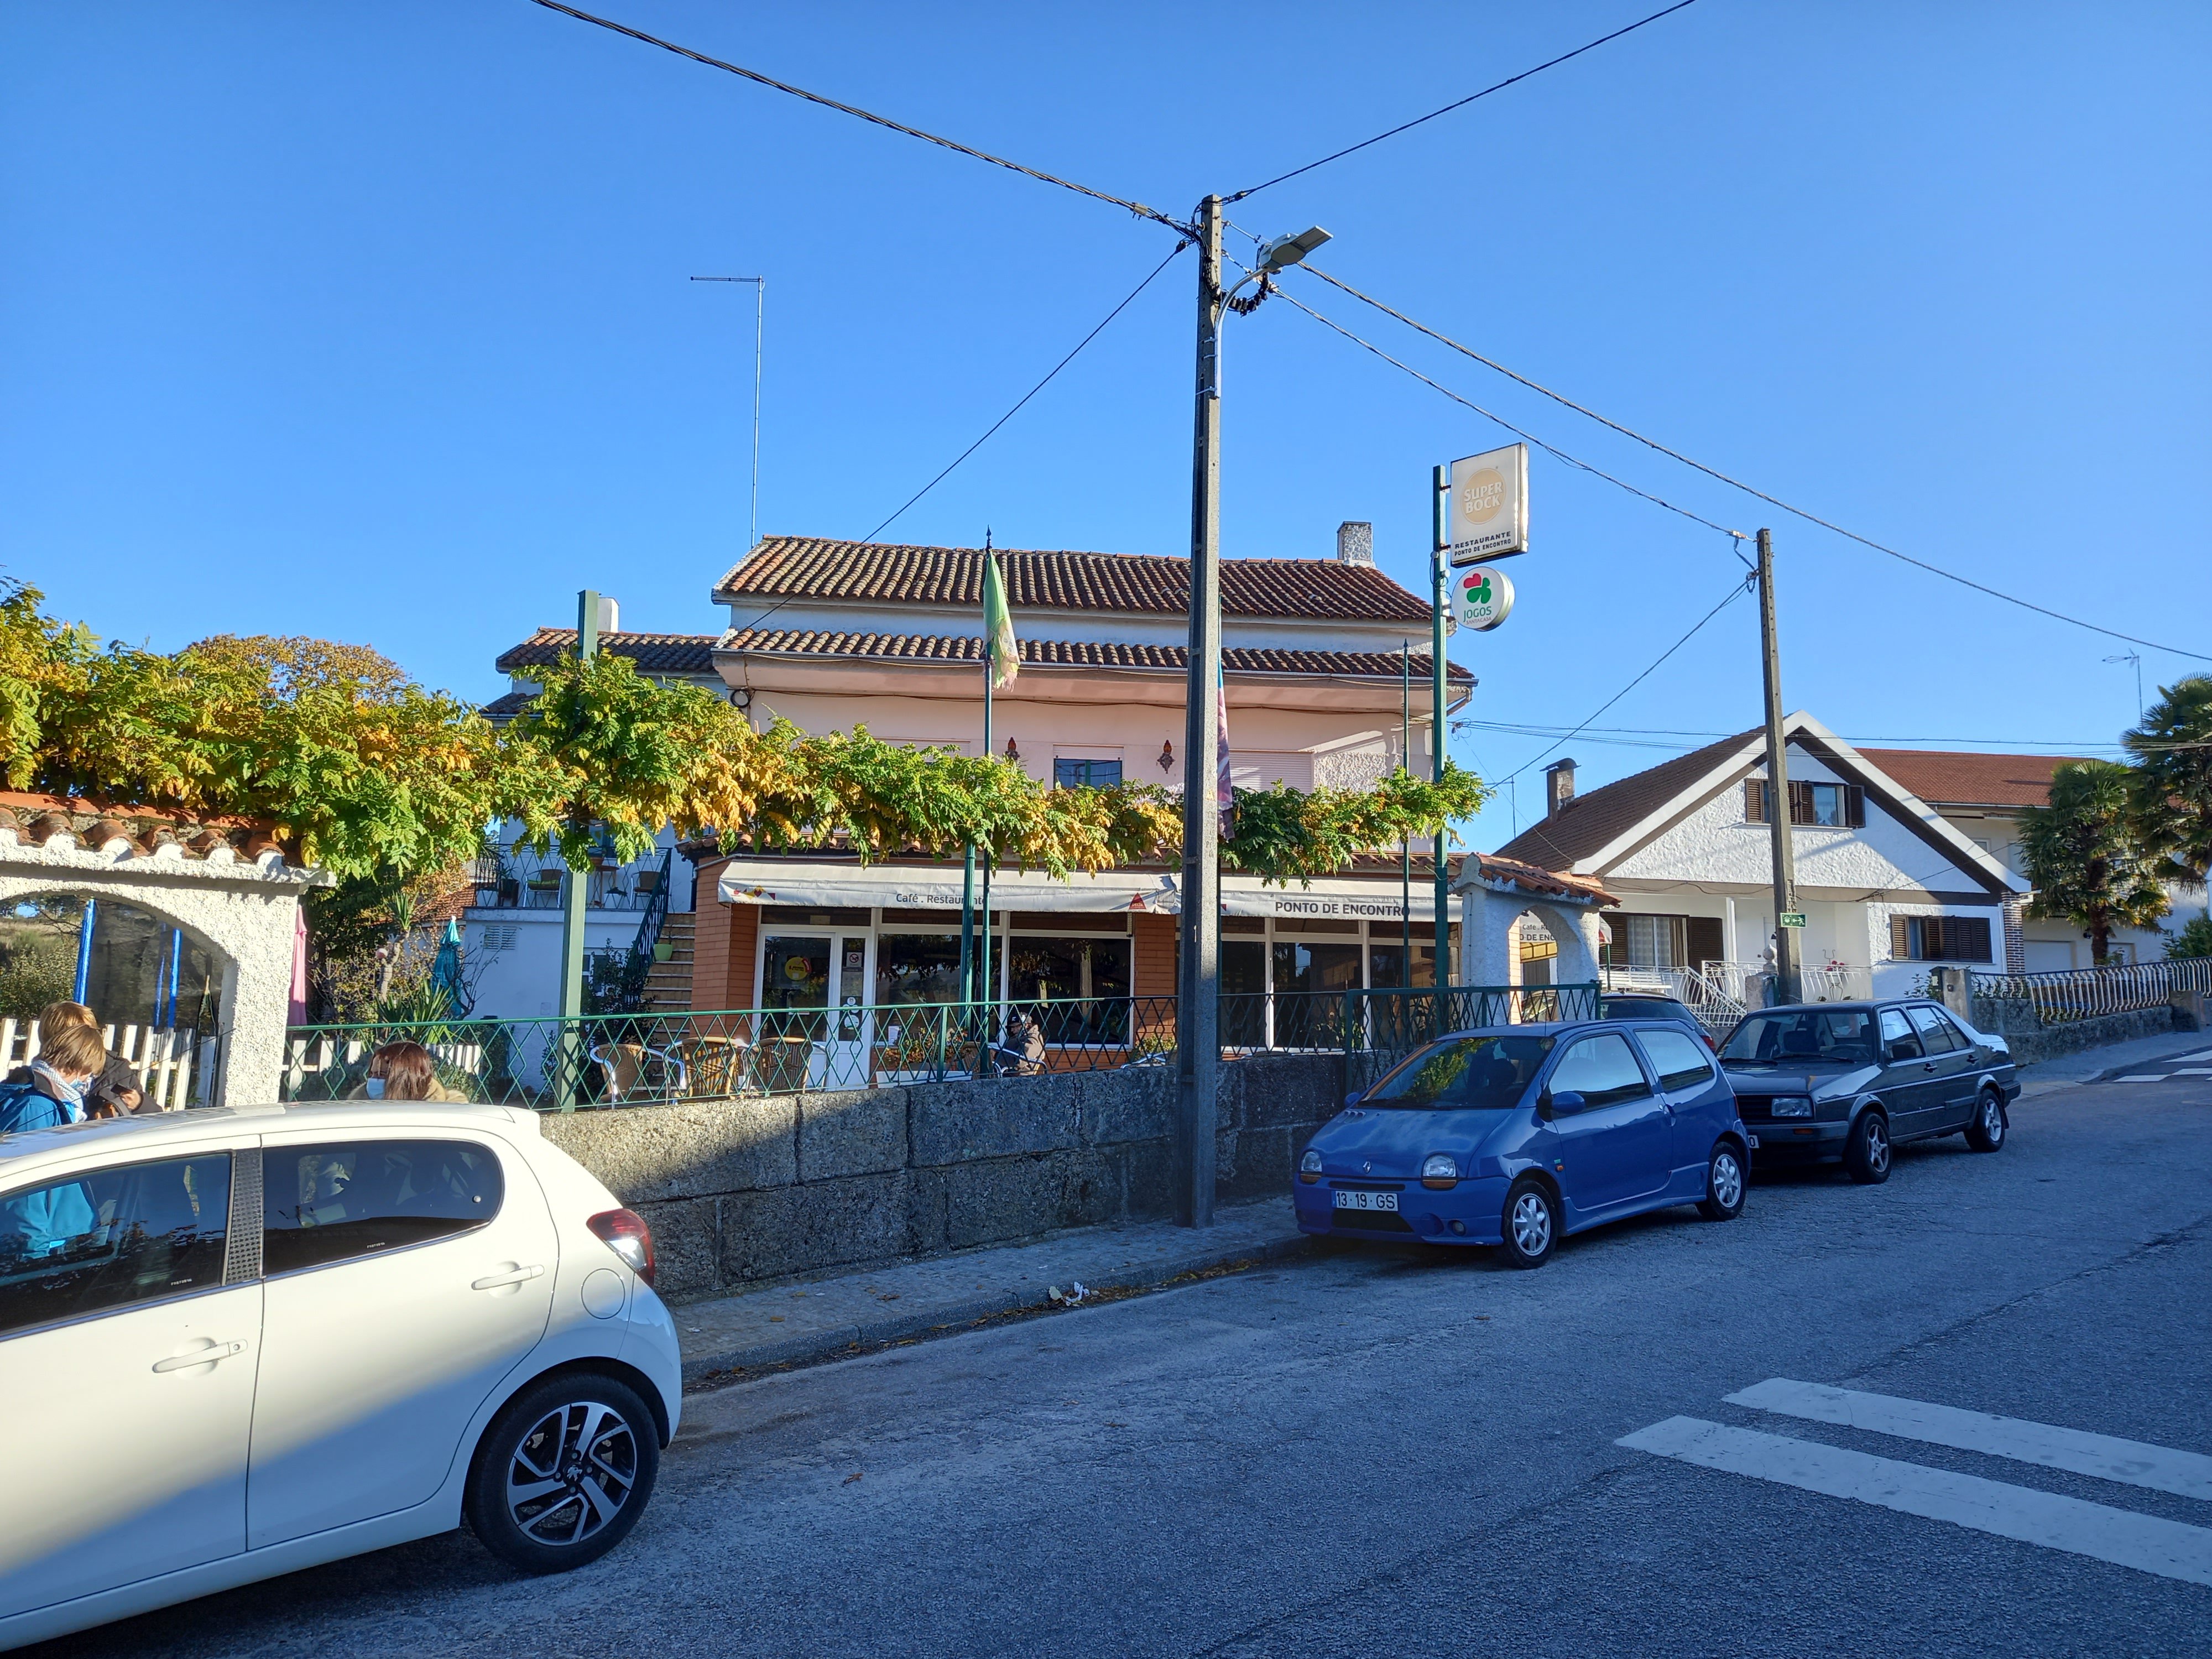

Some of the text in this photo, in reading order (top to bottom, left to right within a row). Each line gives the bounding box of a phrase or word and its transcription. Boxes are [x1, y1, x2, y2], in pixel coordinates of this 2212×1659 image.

[1464, 482, 1503, 502] SUPER
[1465, 495, 1501, 514] BOCK
[1454, 548, 1472, 556] PONTO
[1483, 539, 1511, 550] ENCONTRO
[1455, 531, 1511, 549] RESTAURANTE
[1463, 606, 1492, 622] JOGOS
[896, 893, 918, 902] Café
[1276, 902, 1318, 912] PONTO
[1323, 903, 1339, 914] DE
